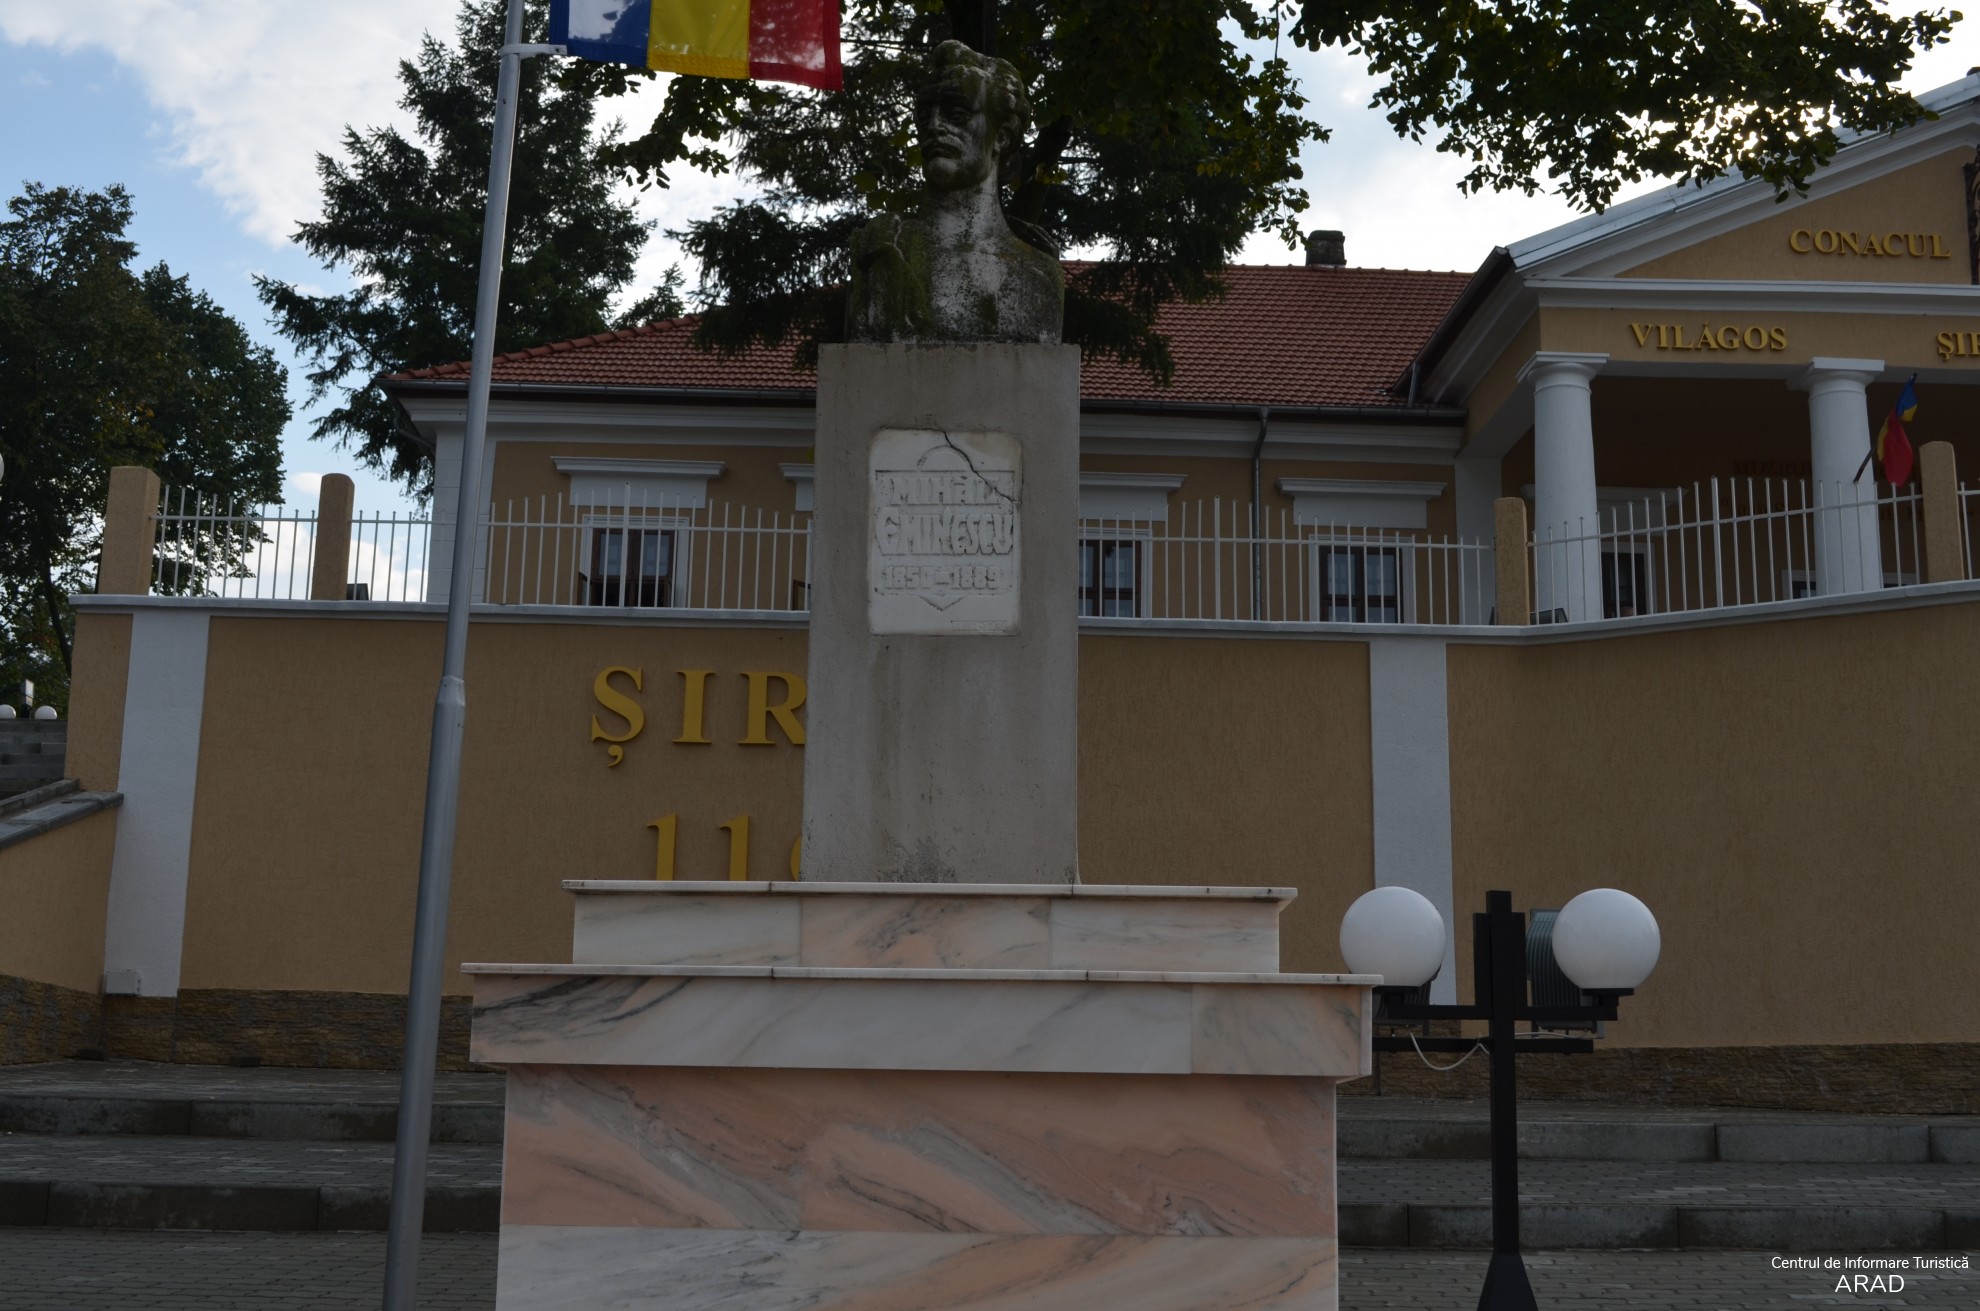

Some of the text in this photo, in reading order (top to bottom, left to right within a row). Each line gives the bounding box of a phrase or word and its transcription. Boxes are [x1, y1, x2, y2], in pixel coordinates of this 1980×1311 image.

[1789, 229, 1951, 258] CONACUL
[1630, 322, 1788, 351] VILÁGOS
[874, 506, 1014, 556] EMINESCU
[646, 813, 802, 881] 11
